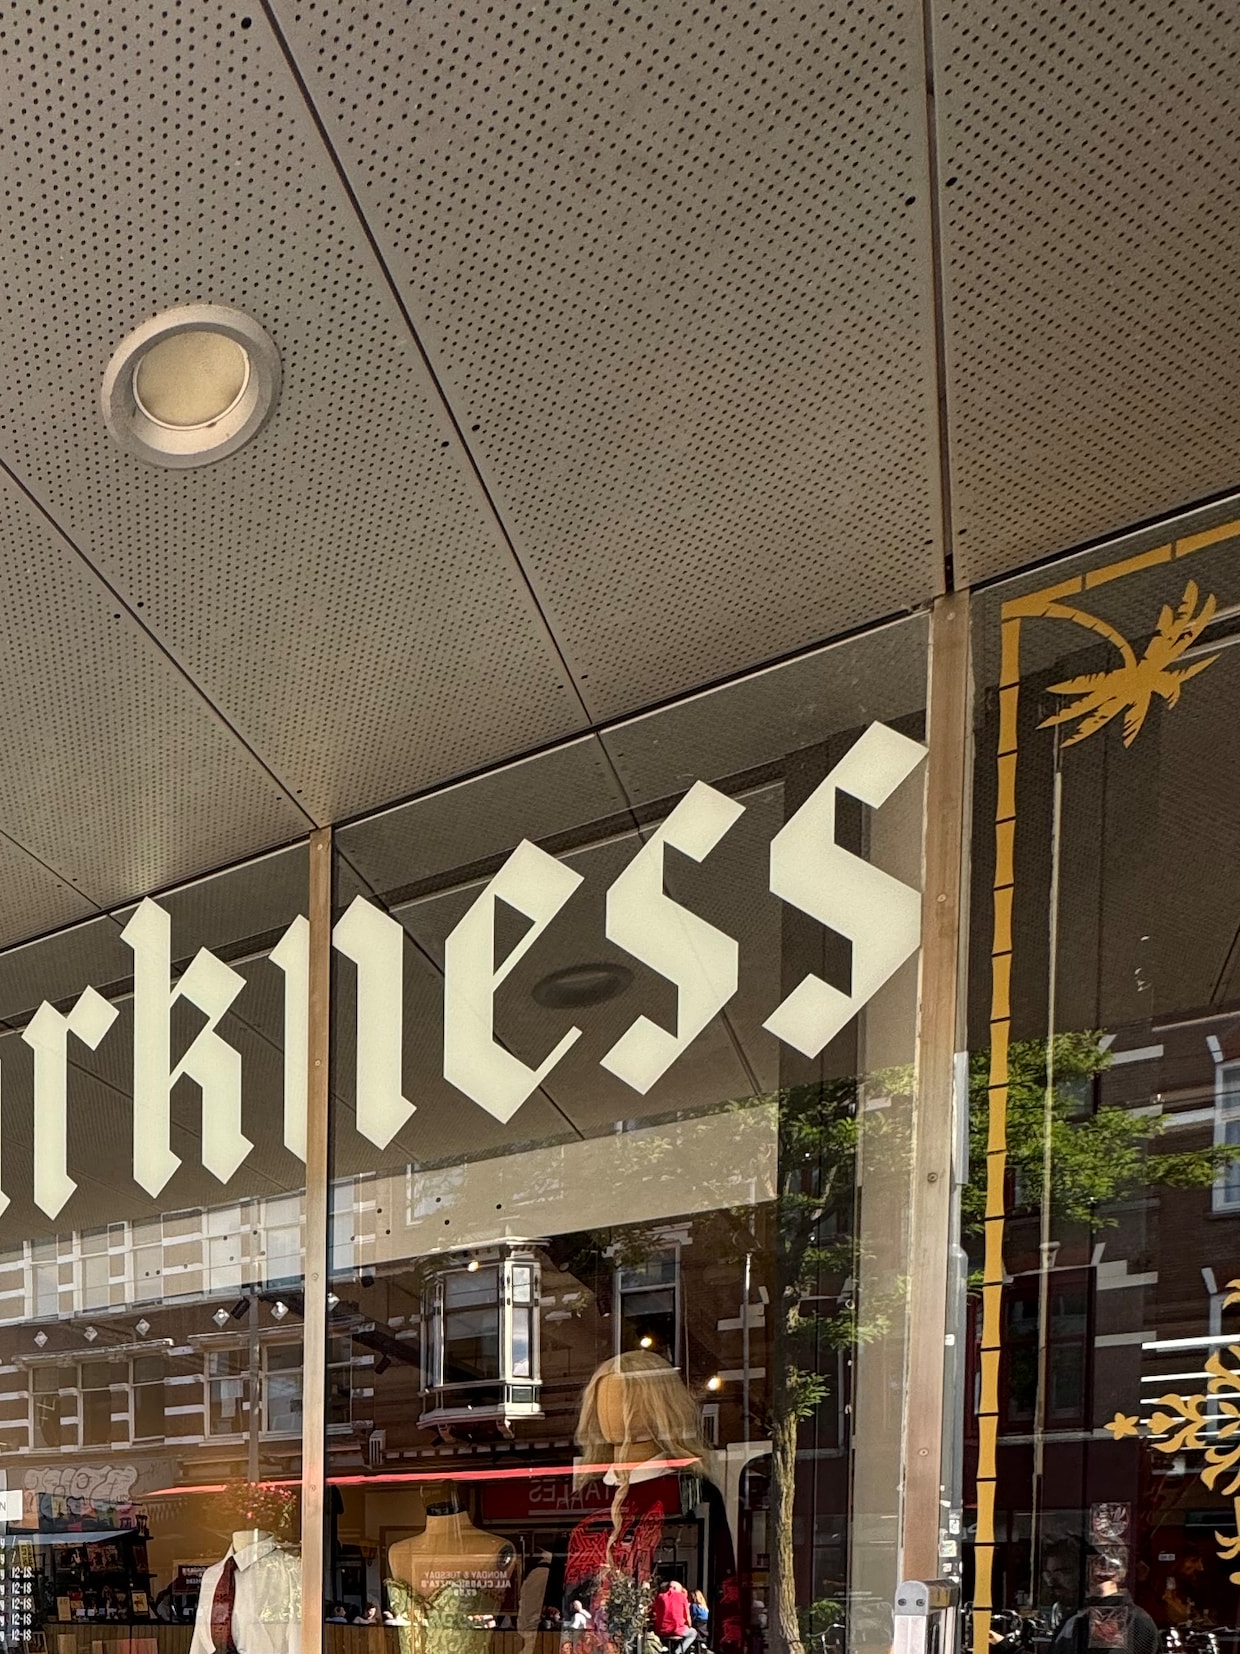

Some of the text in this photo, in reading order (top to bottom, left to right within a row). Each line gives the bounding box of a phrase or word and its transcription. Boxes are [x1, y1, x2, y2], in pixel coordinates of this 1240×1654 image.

[11, 1567, 32, 1579] 12-18
[11, 1582, 32, 1594] 12-18
[11, 1597, 32, 1609] 12-18
[11, 1612, 32, 1625] 12-18
[11, 1629, 32, 1641] 12-18
